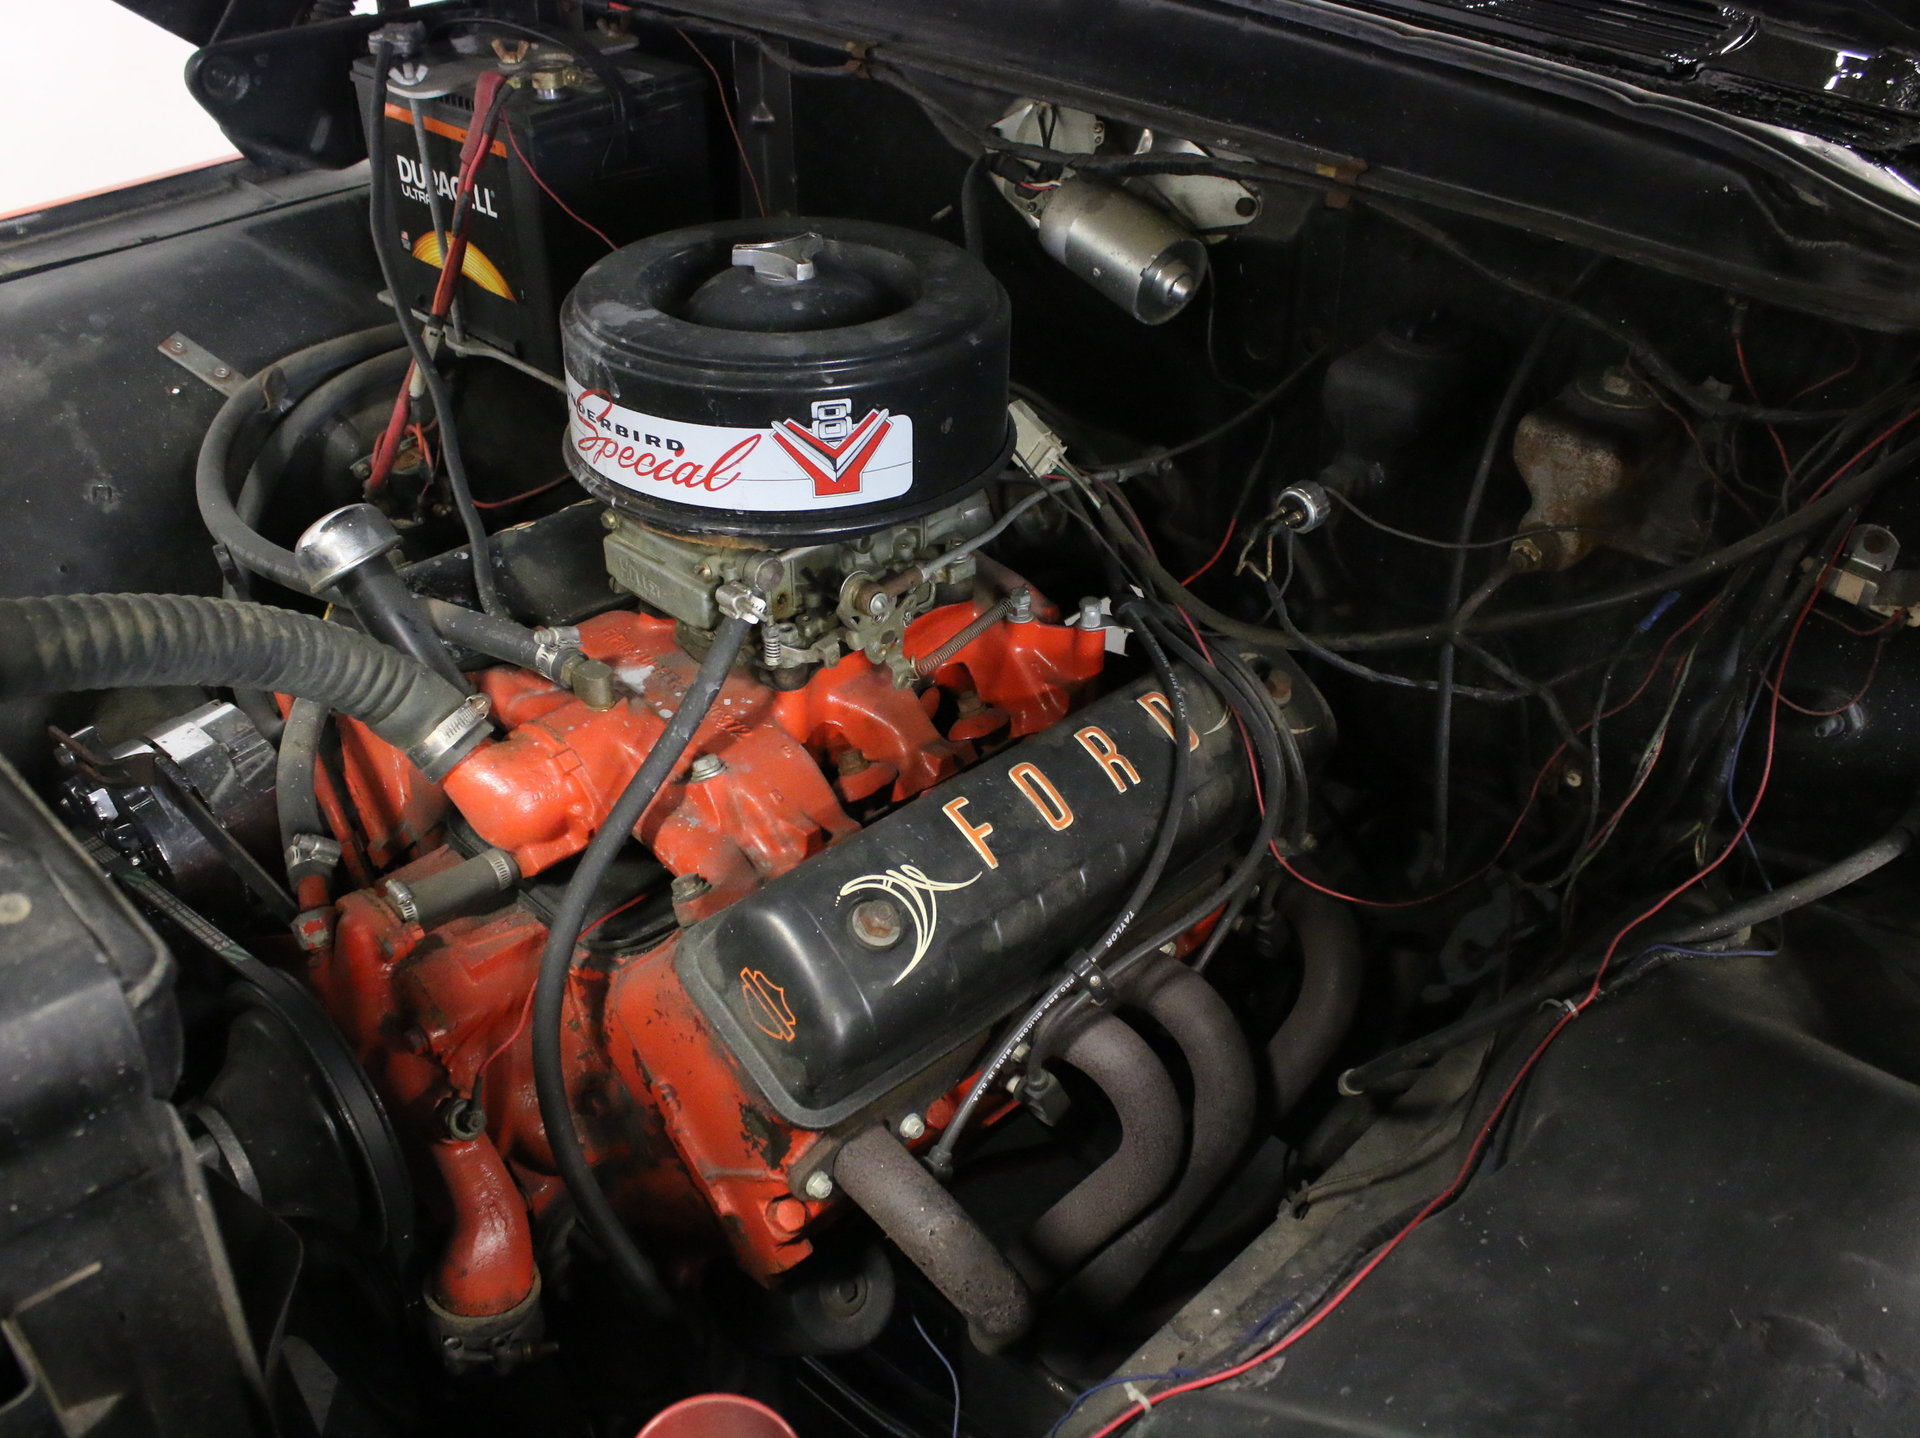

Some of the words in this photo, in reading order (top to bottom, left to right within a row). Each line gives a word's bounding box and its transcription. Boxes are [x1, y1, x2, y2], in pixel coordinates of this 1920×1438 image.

[396, 154, 498, 219] DUACLL
[576, 388, 762, 491] Special
[942, 691, 1200, 870] FORD
[1105, 910, 1135, 948] TAYLOR
[1060, 978, 1075, 993] PRO
[1015, 1011, 1043, 1043] SILICONE
[987, 1071, 996, 1080] IN
[994, 1048, 1012, 1069] MADE
